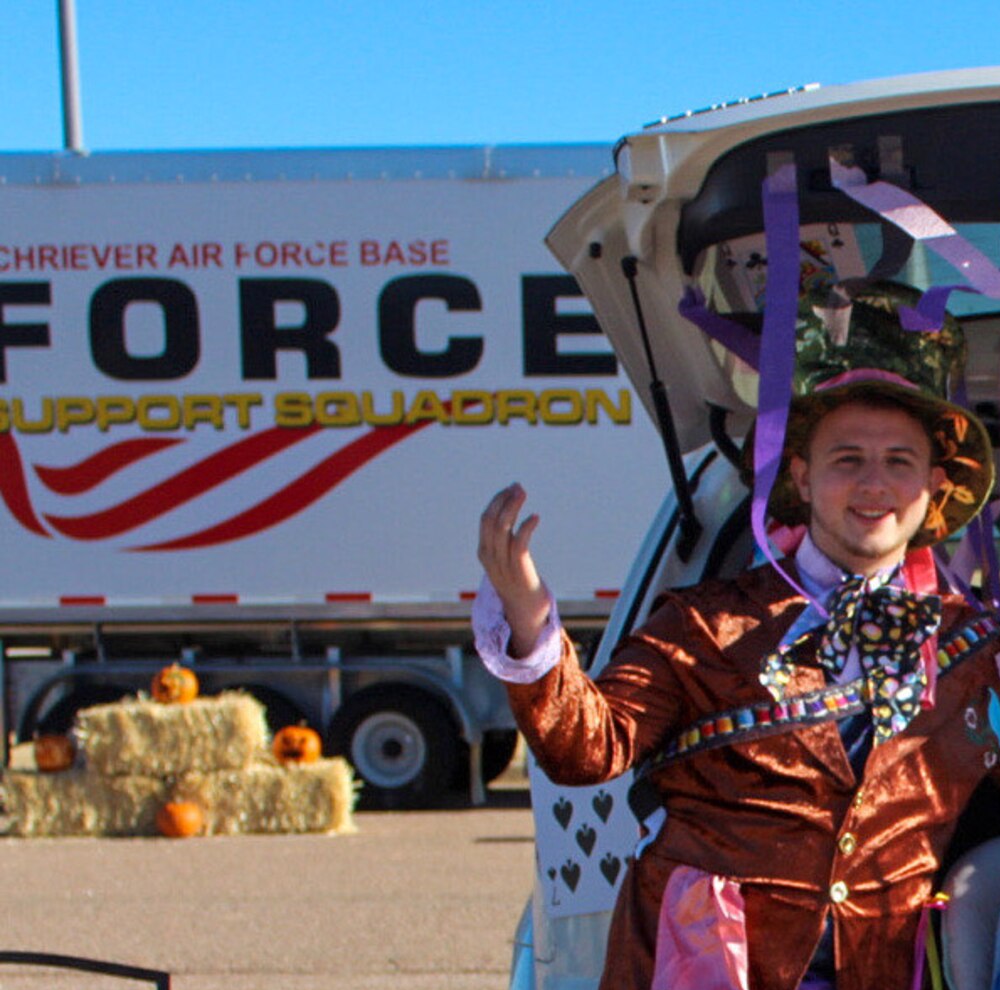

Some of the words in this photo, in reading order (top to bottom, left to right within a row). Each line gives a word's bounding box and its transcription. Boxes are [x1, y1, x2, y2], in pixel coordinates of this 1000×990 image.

[168, 242, 223, 269] AIR
[234, 240, 349, 268] FORCE
[360, 240, 449, 267] BASE
[0, 274, 618, 383] FORCE
[0, 393, 263, 434] UPPORT
[274, 388, 632, 427] SQUADRON
